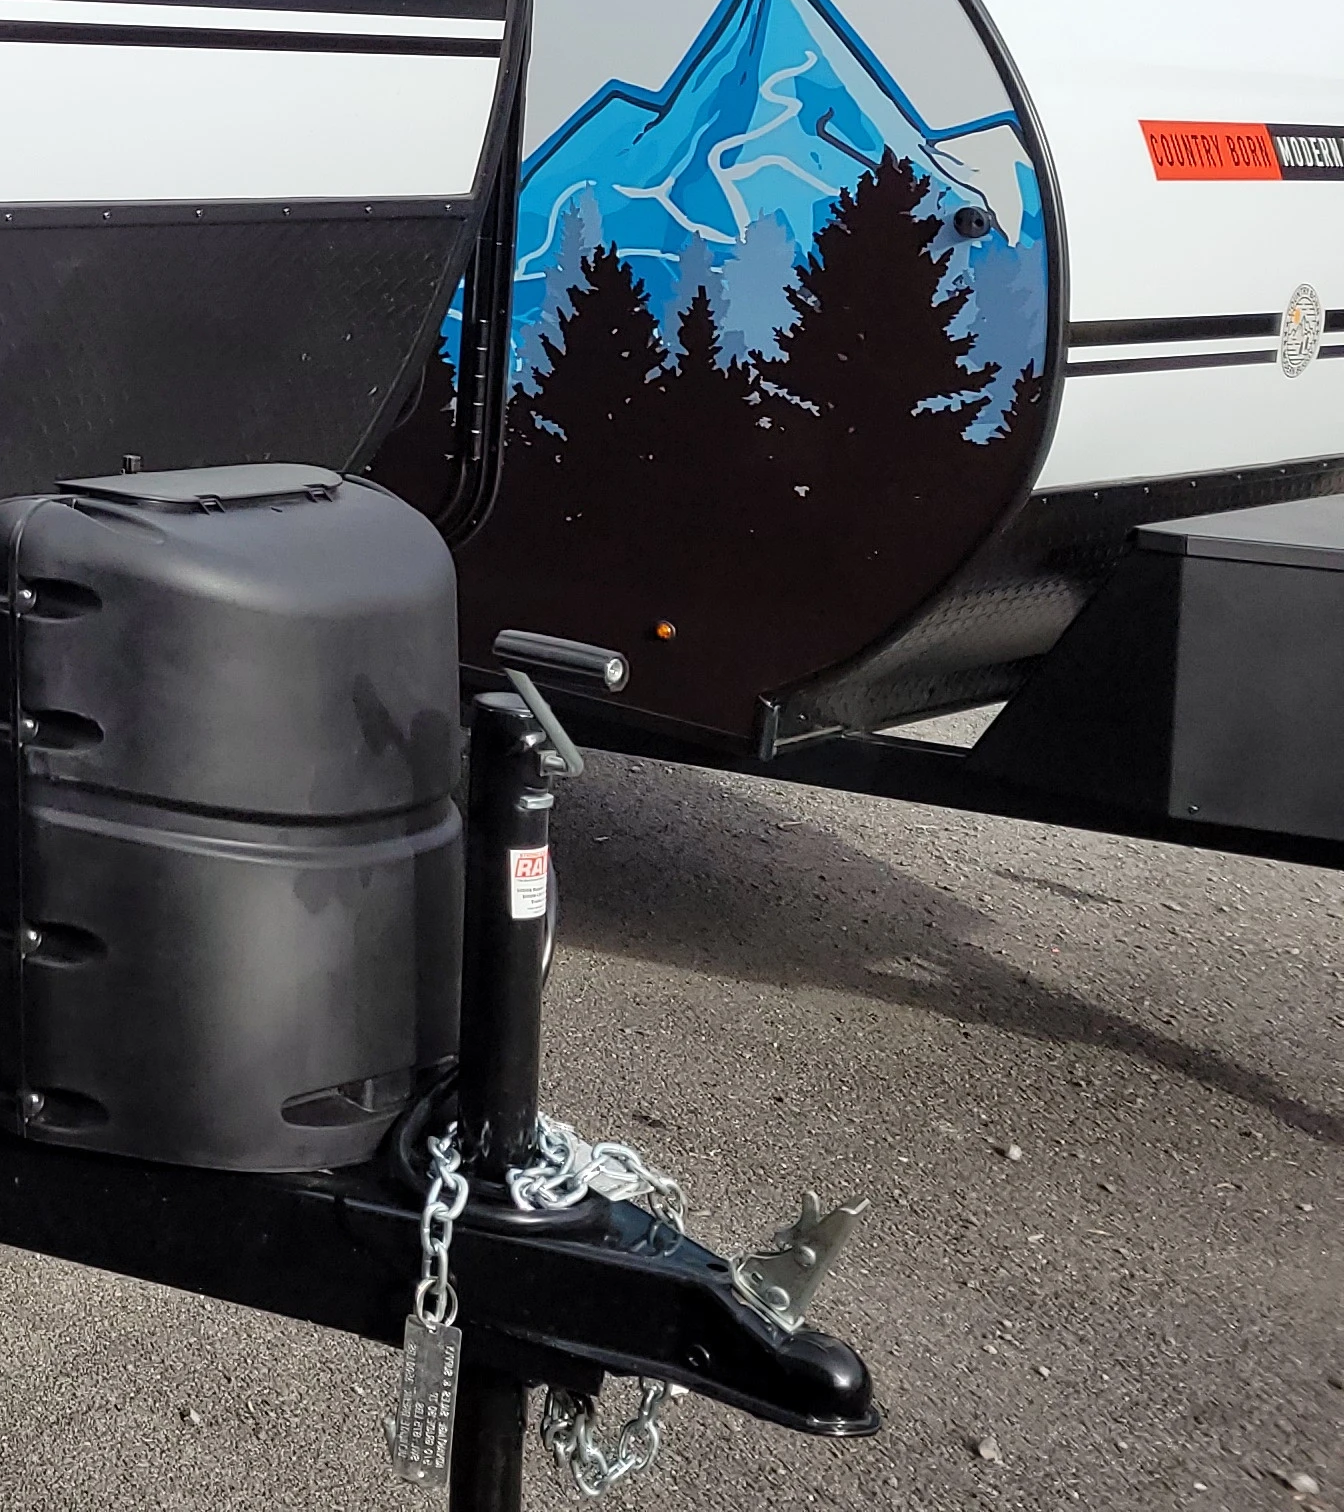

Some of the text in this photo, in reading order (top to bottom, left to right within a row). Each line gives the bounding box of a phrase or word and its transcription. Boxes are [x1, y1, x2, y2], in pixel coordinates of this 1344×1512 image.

[1149, 133, 1344, 168] COUNTRY BORN MODERN
